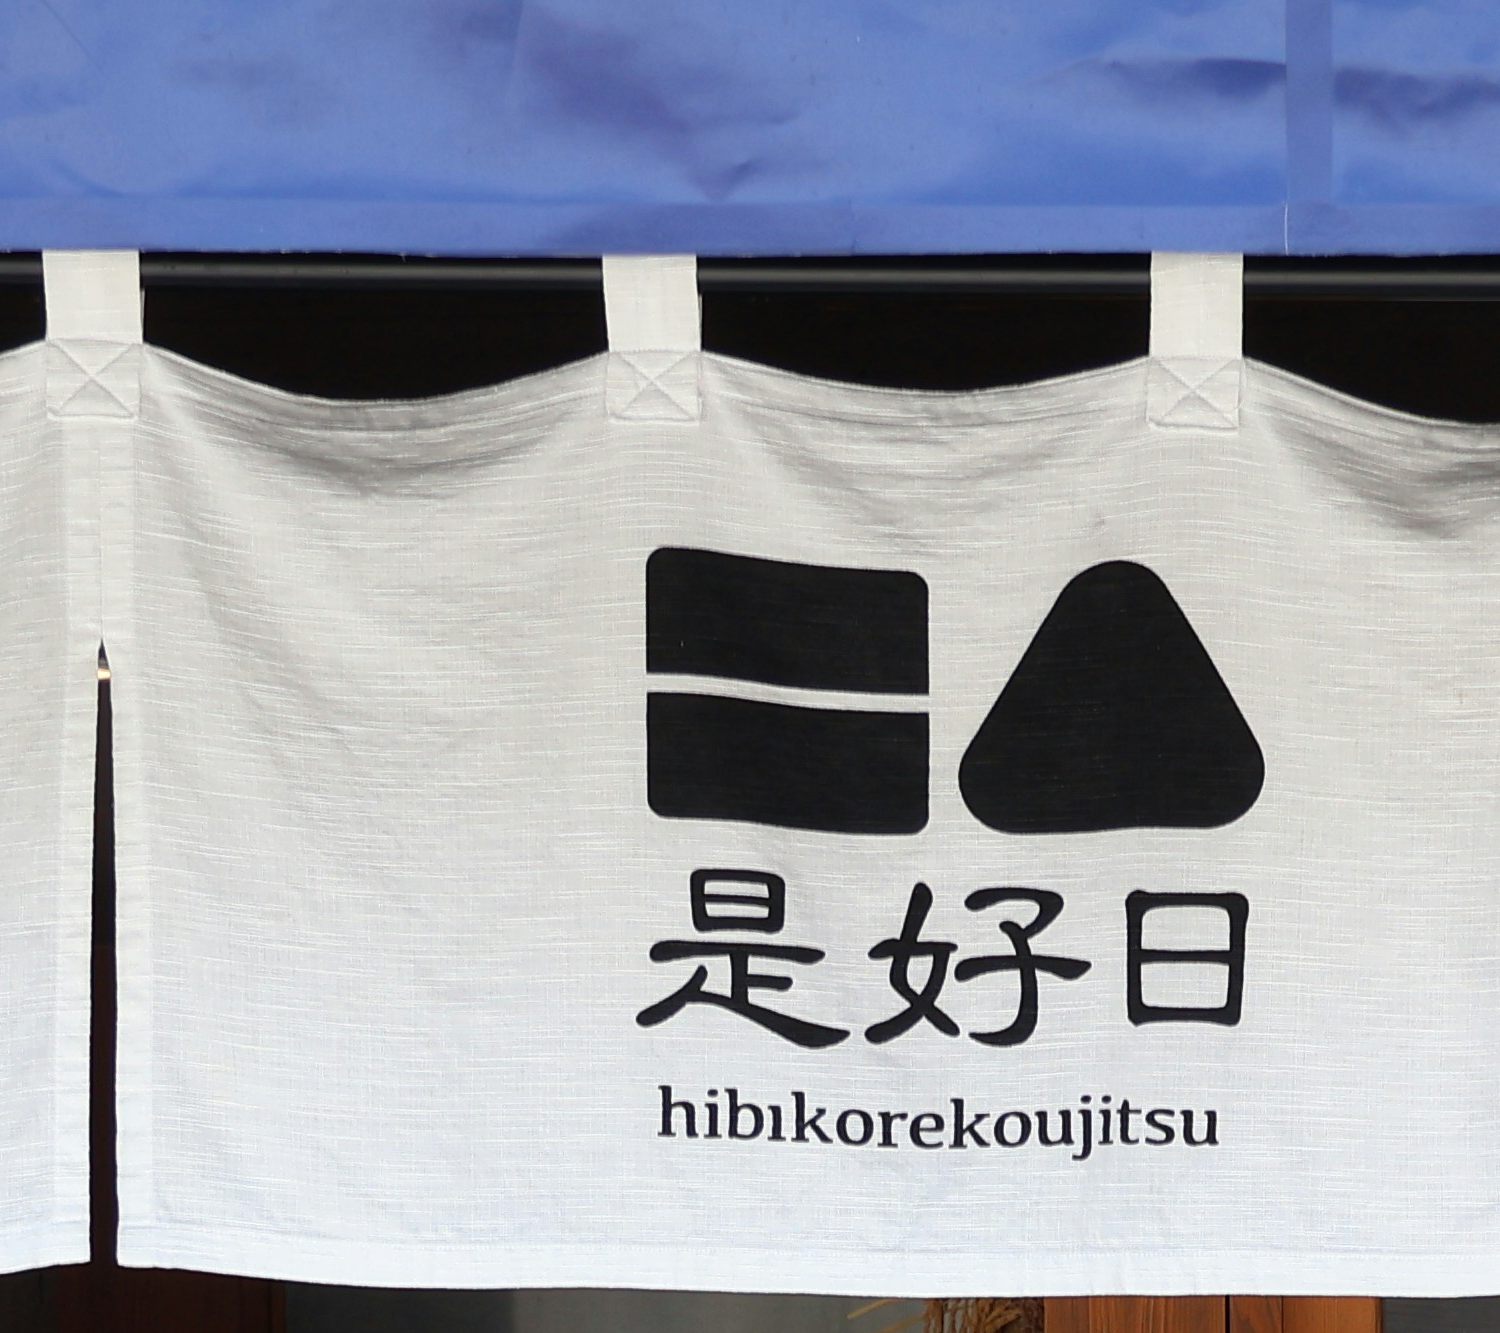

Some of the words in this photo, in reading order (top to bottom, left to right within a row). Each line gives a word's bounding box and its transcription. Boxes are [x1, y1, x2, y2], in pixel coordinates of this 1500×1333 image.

[636, 869, 1249, 1049] 是好日
[657, 1085, 1219, 1161] hibikorekoujitsu
